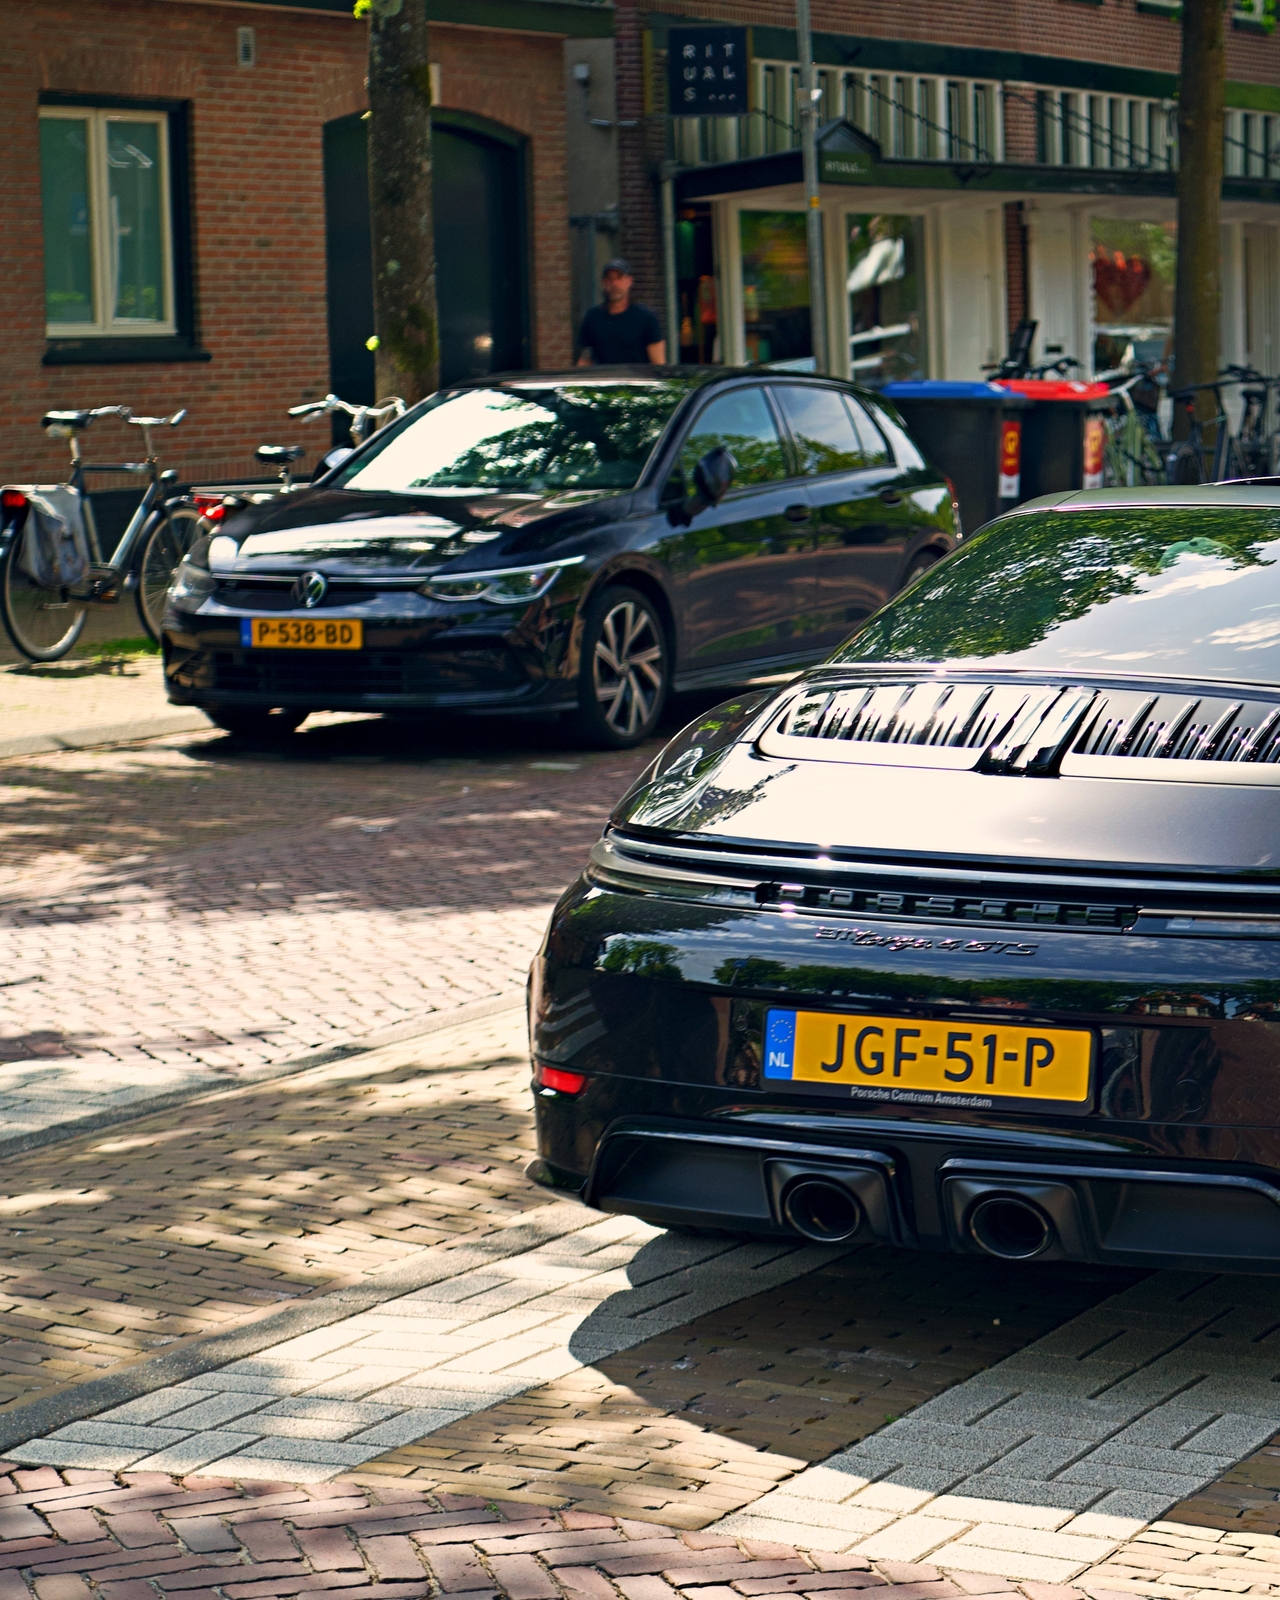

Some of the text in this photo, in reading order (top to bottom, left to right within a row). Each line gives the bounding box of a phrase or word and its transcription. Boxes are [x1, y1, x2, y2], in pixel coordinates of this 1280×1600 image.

[682, 43, 736, 59] RIT
[682, 65, 737, 81] UAL
[258, 622, 353, 644] P-538-BD
[779, 885, 1117, 924] PORSCHE
[961, 940, 1040, 956] GTS
[768, 1024, 1055, 1088] NL JGF-51-P
[850, 1086, 993, 1108] Porsche Centrum Amsterdam
